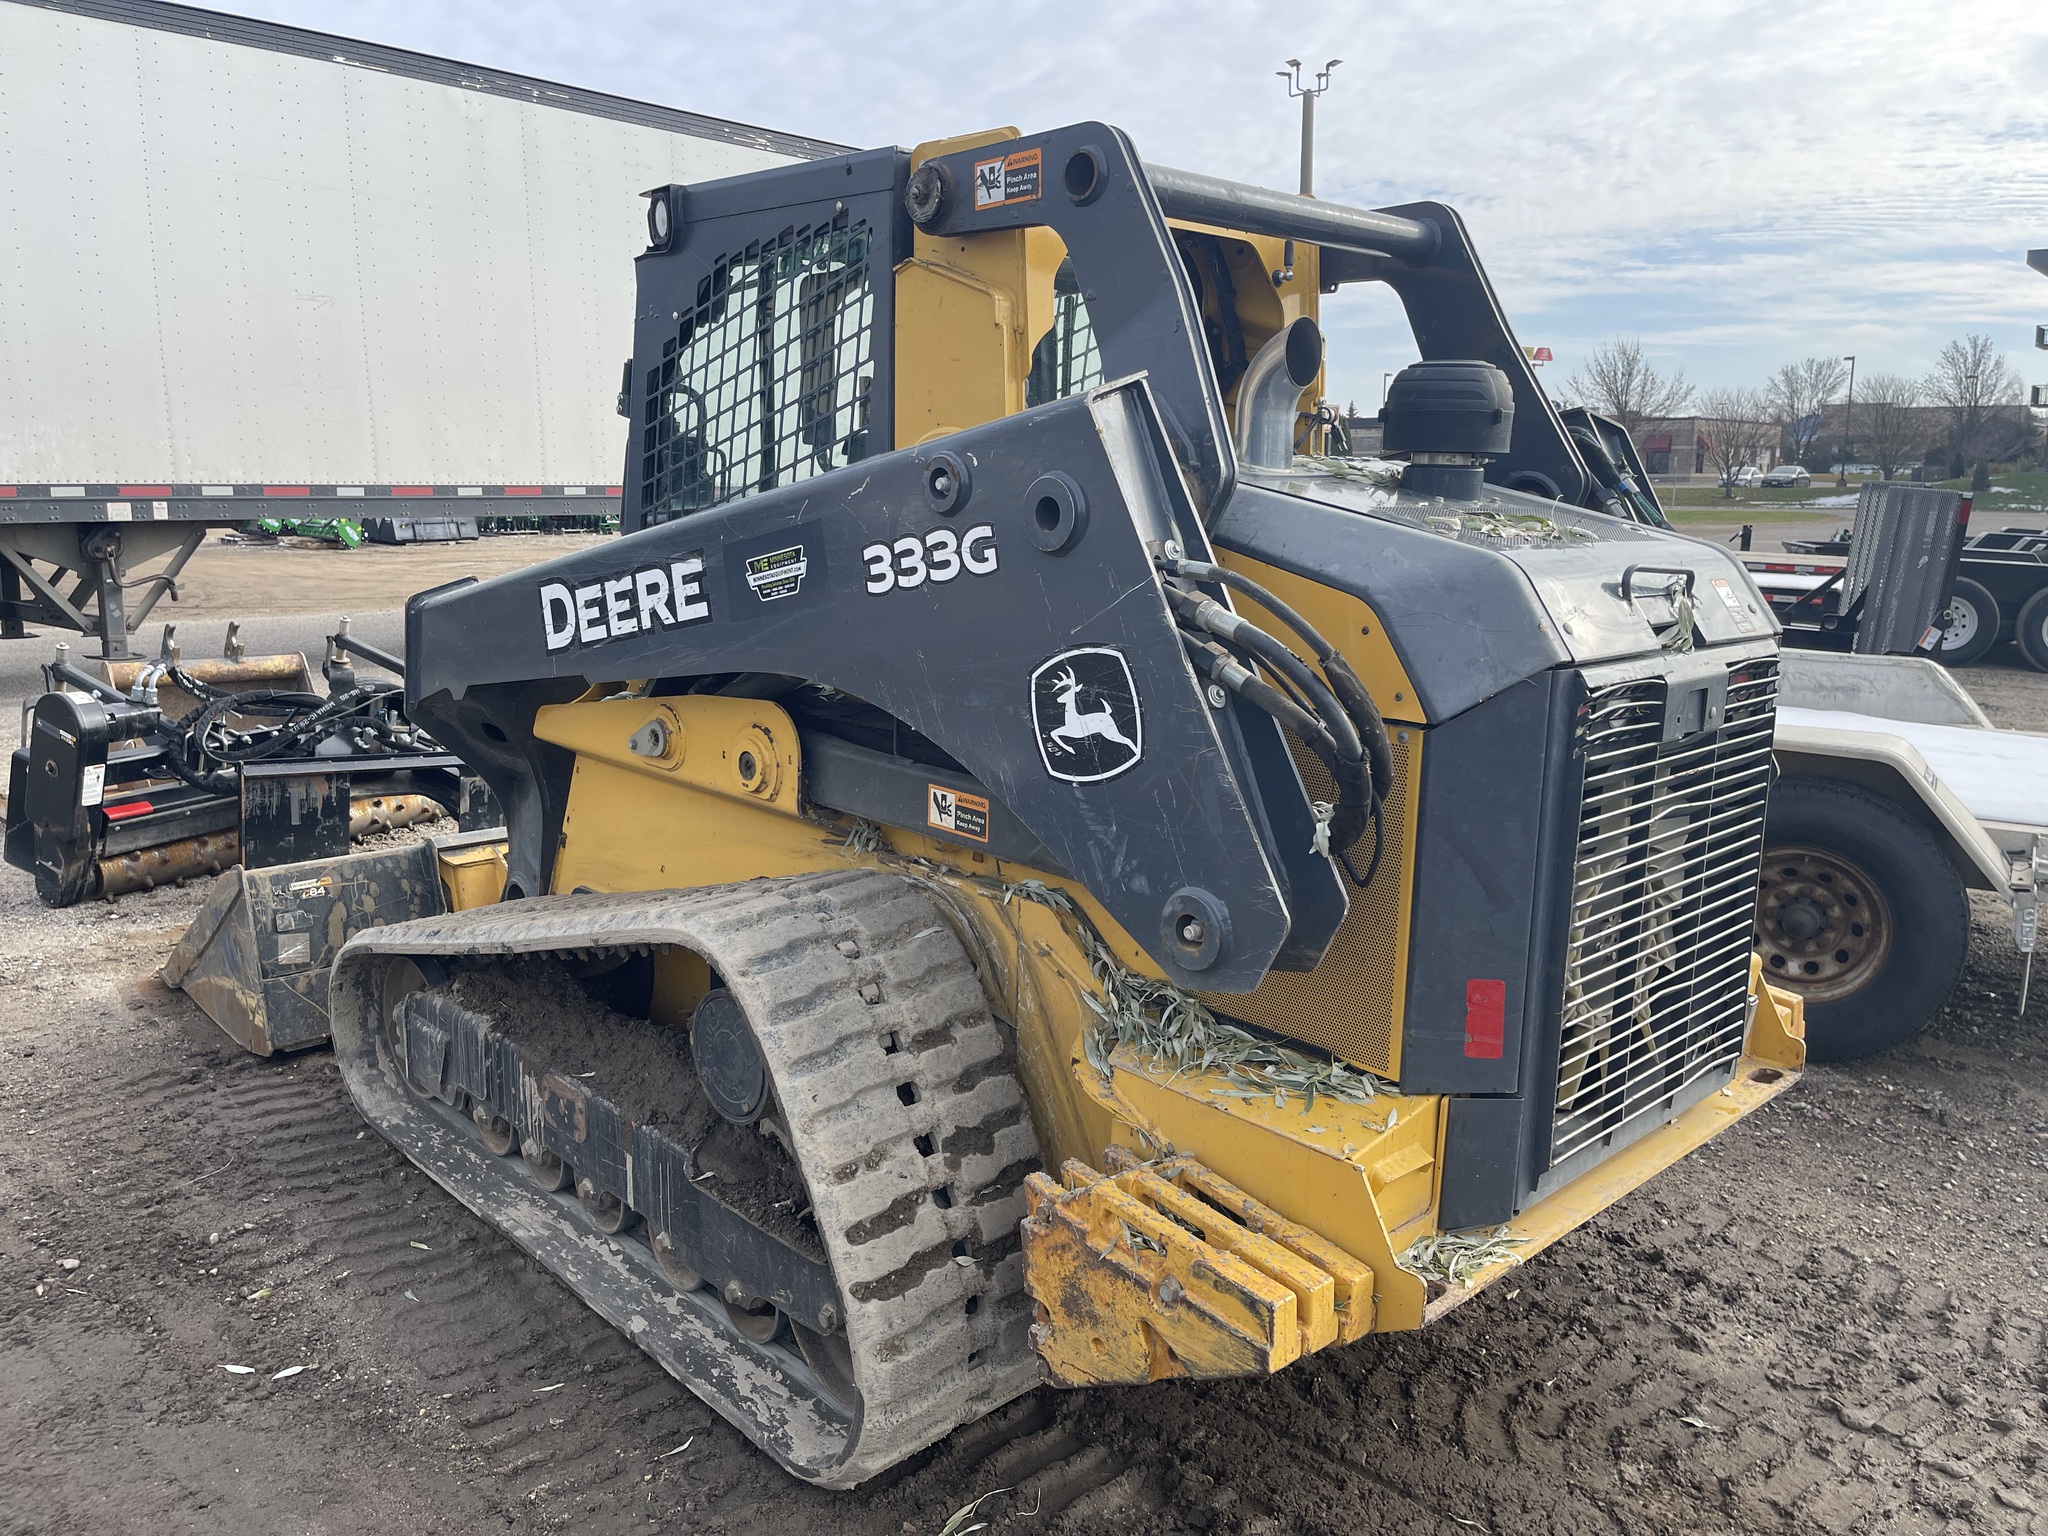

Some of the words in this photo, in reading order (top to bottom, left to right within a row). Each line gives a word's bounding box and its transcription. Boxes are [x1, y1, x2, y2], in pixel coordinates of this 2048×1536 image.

[1012, 153, 1038, 165] WARNING
[1006, 174, 1023, 185] Pinch
[1023, 172, 1037, 180] Area
[1006, 186, 1020, 194] Keep
[1020, 184, 1032, 192] Away
[769, 551, 797, 563] MINNESOTA
[863, 525, 998, 594] 333G
[540, 558, 709, 650] DEERE
[963, 797, 986, 809] WARNING
[956, 811, 972, 821] Pinch
[972, 815, 985, 825] Area
[956, 820, 968, 829] Keep
[968, 824, 981, 832] Away
